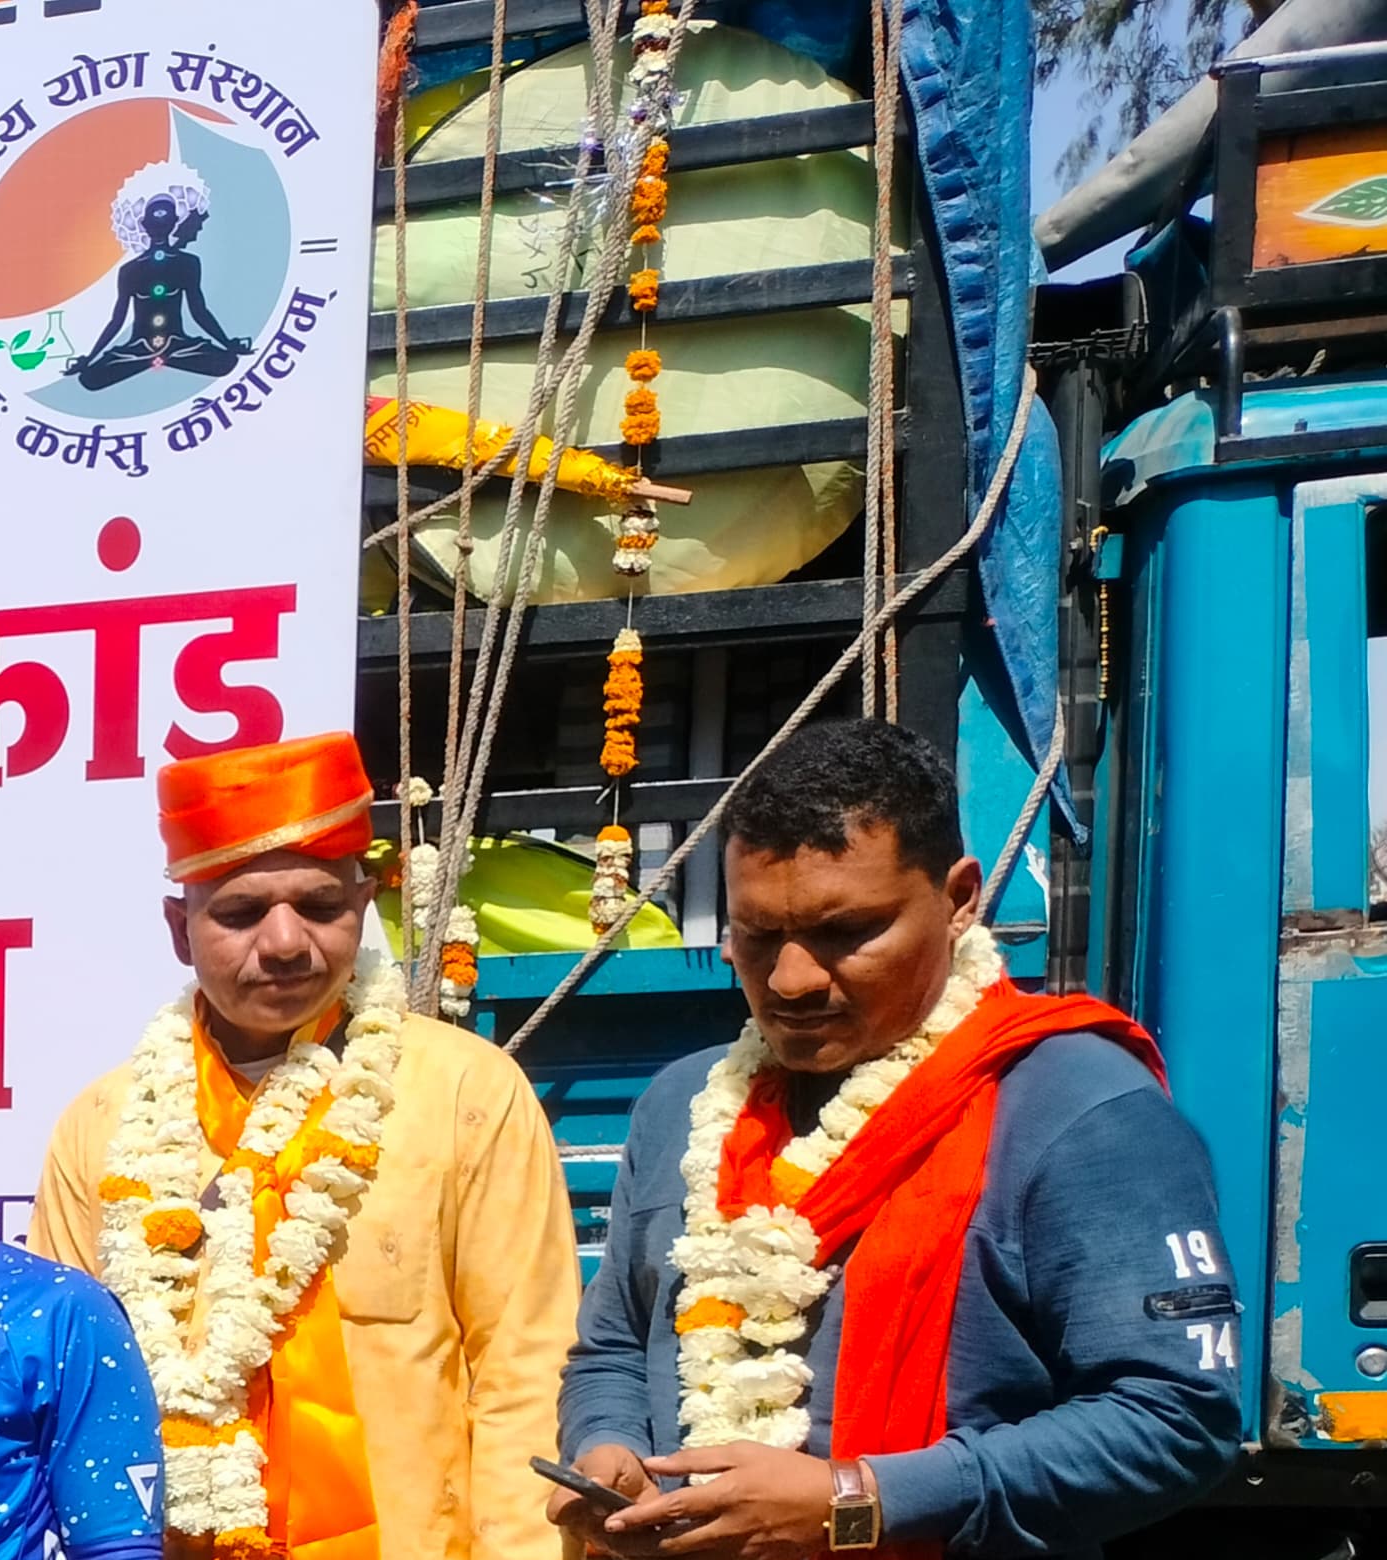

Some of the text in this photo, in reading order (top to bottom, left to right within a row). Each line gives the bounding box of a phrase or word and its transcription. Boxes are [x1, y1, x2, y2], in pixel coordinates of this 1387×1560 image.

[43, 52, 150, 107] योग
[166, 43, 321, 158] संस्थान
[16, 416, 150, 478] कर्मसु
[1165, 1230, 1217, 1279] 19
[1186, 1321, 1236, 1371] 74
